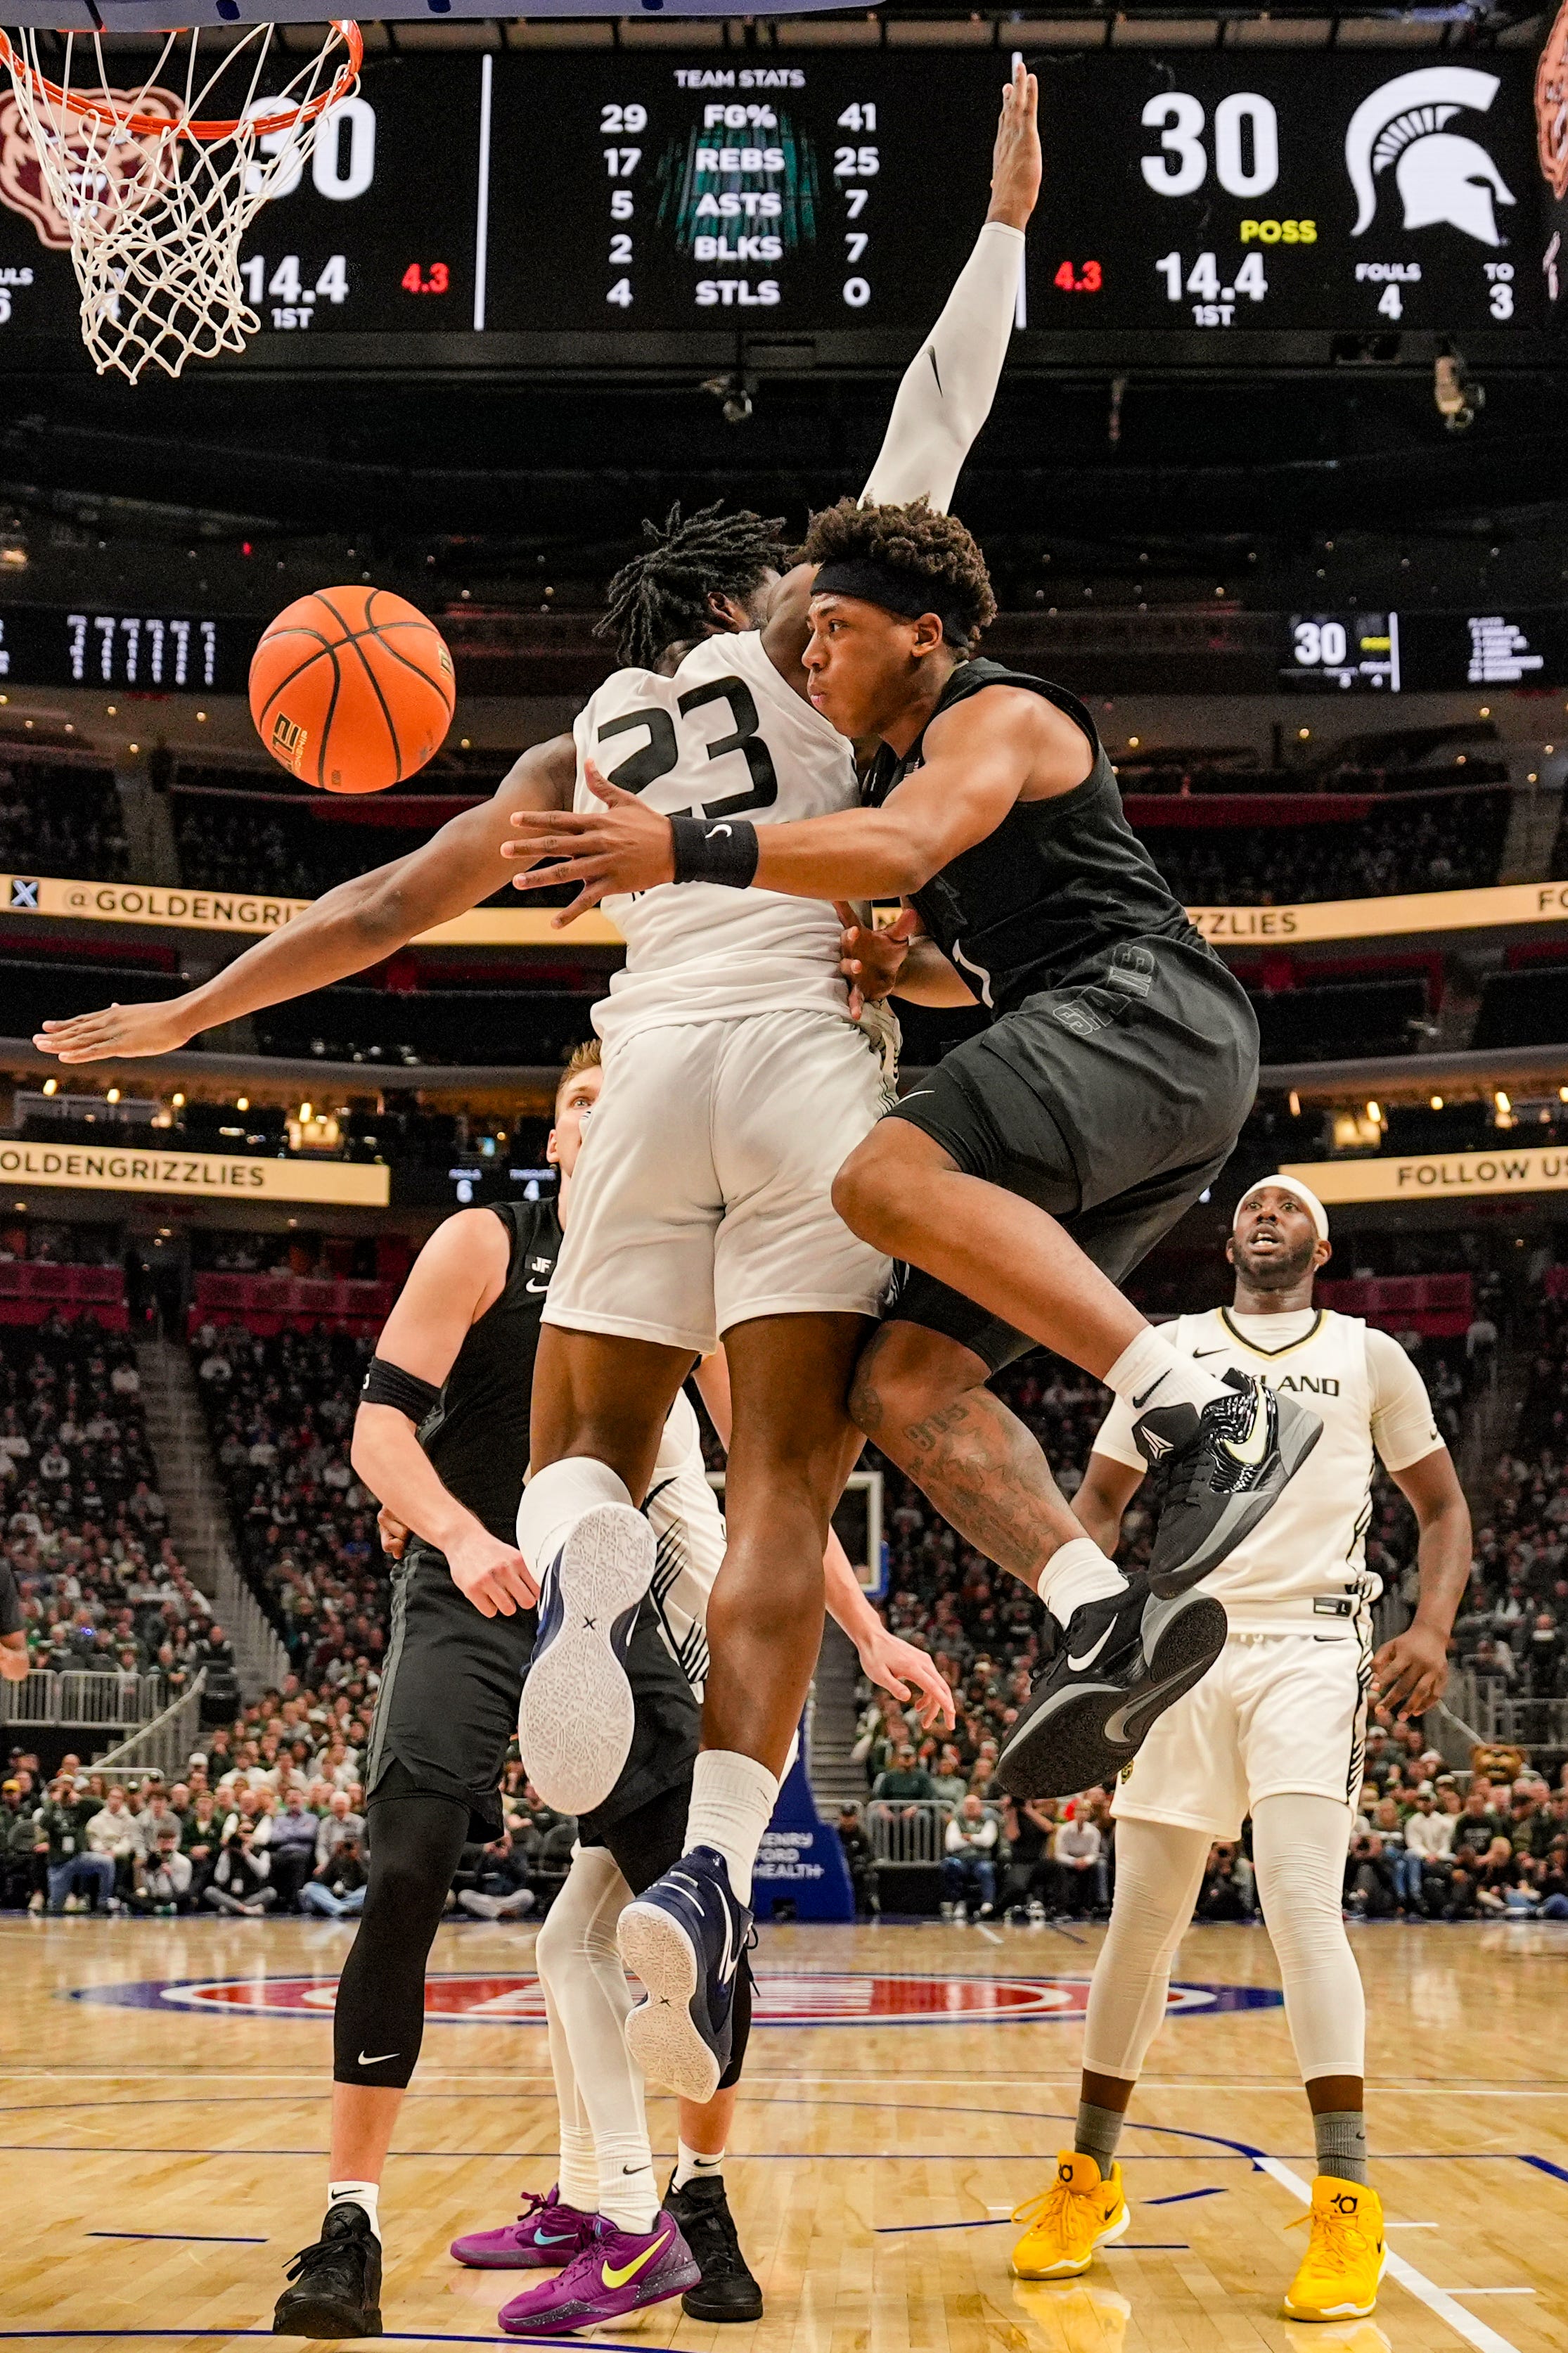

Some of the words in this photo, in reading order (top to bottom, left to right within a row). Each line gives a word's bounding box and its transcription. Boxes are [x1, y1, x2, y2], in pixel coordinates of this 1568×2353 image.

[674, 69, 735, 88] TEAM
[738, 69, 806, 88] STATS
[600, 103, 648, 133] 29
[704, 104, 778, 129] FG%
[837, 103, 877, 132] 41
[1140, 91, 1279, 198] 30
[603, 148, 642, 177] 17
[695, 147, 785, 173] REBS
[833, 146, 880, 177] 25
[610, 190, 634, 219] 5
[695, 192, 782, 218] ASTS
[844, 189, 868, 219] 7
[1240, 219, 1318, 244] POSS
[609, 233, 633, 264] 2
[694, 235, 783, 261] BLKS
[844, 233, 868, 263] 7
[240, 255, 349, 304] 14.4
[401, 262, 450, 294] 4.3
[1054, 260, 1103, 292] 4.3
[1155, 251, 1268, 301] 14.4
[1355, 262, 1422, 281] FOULS
[1483, 262, 1515, 281] TO
[607, 278, 634, 307] 4
[695, 279, 780, 305] STLS
[843, 277, 871, 307] 0
[1377, 283, 1403, 320] 4
[1489, 283, 1514, 320] 3
[271, 307, 314, 329] 1ST
[1192, 304, 1235, 326] 1ST
[1294, 622, 1347, 665] 30
[598, 675, 778, 819] 23
[1398, 1159, 1529, 1186] FOLLOW
[1542, 1156, 1568, 1177] U
